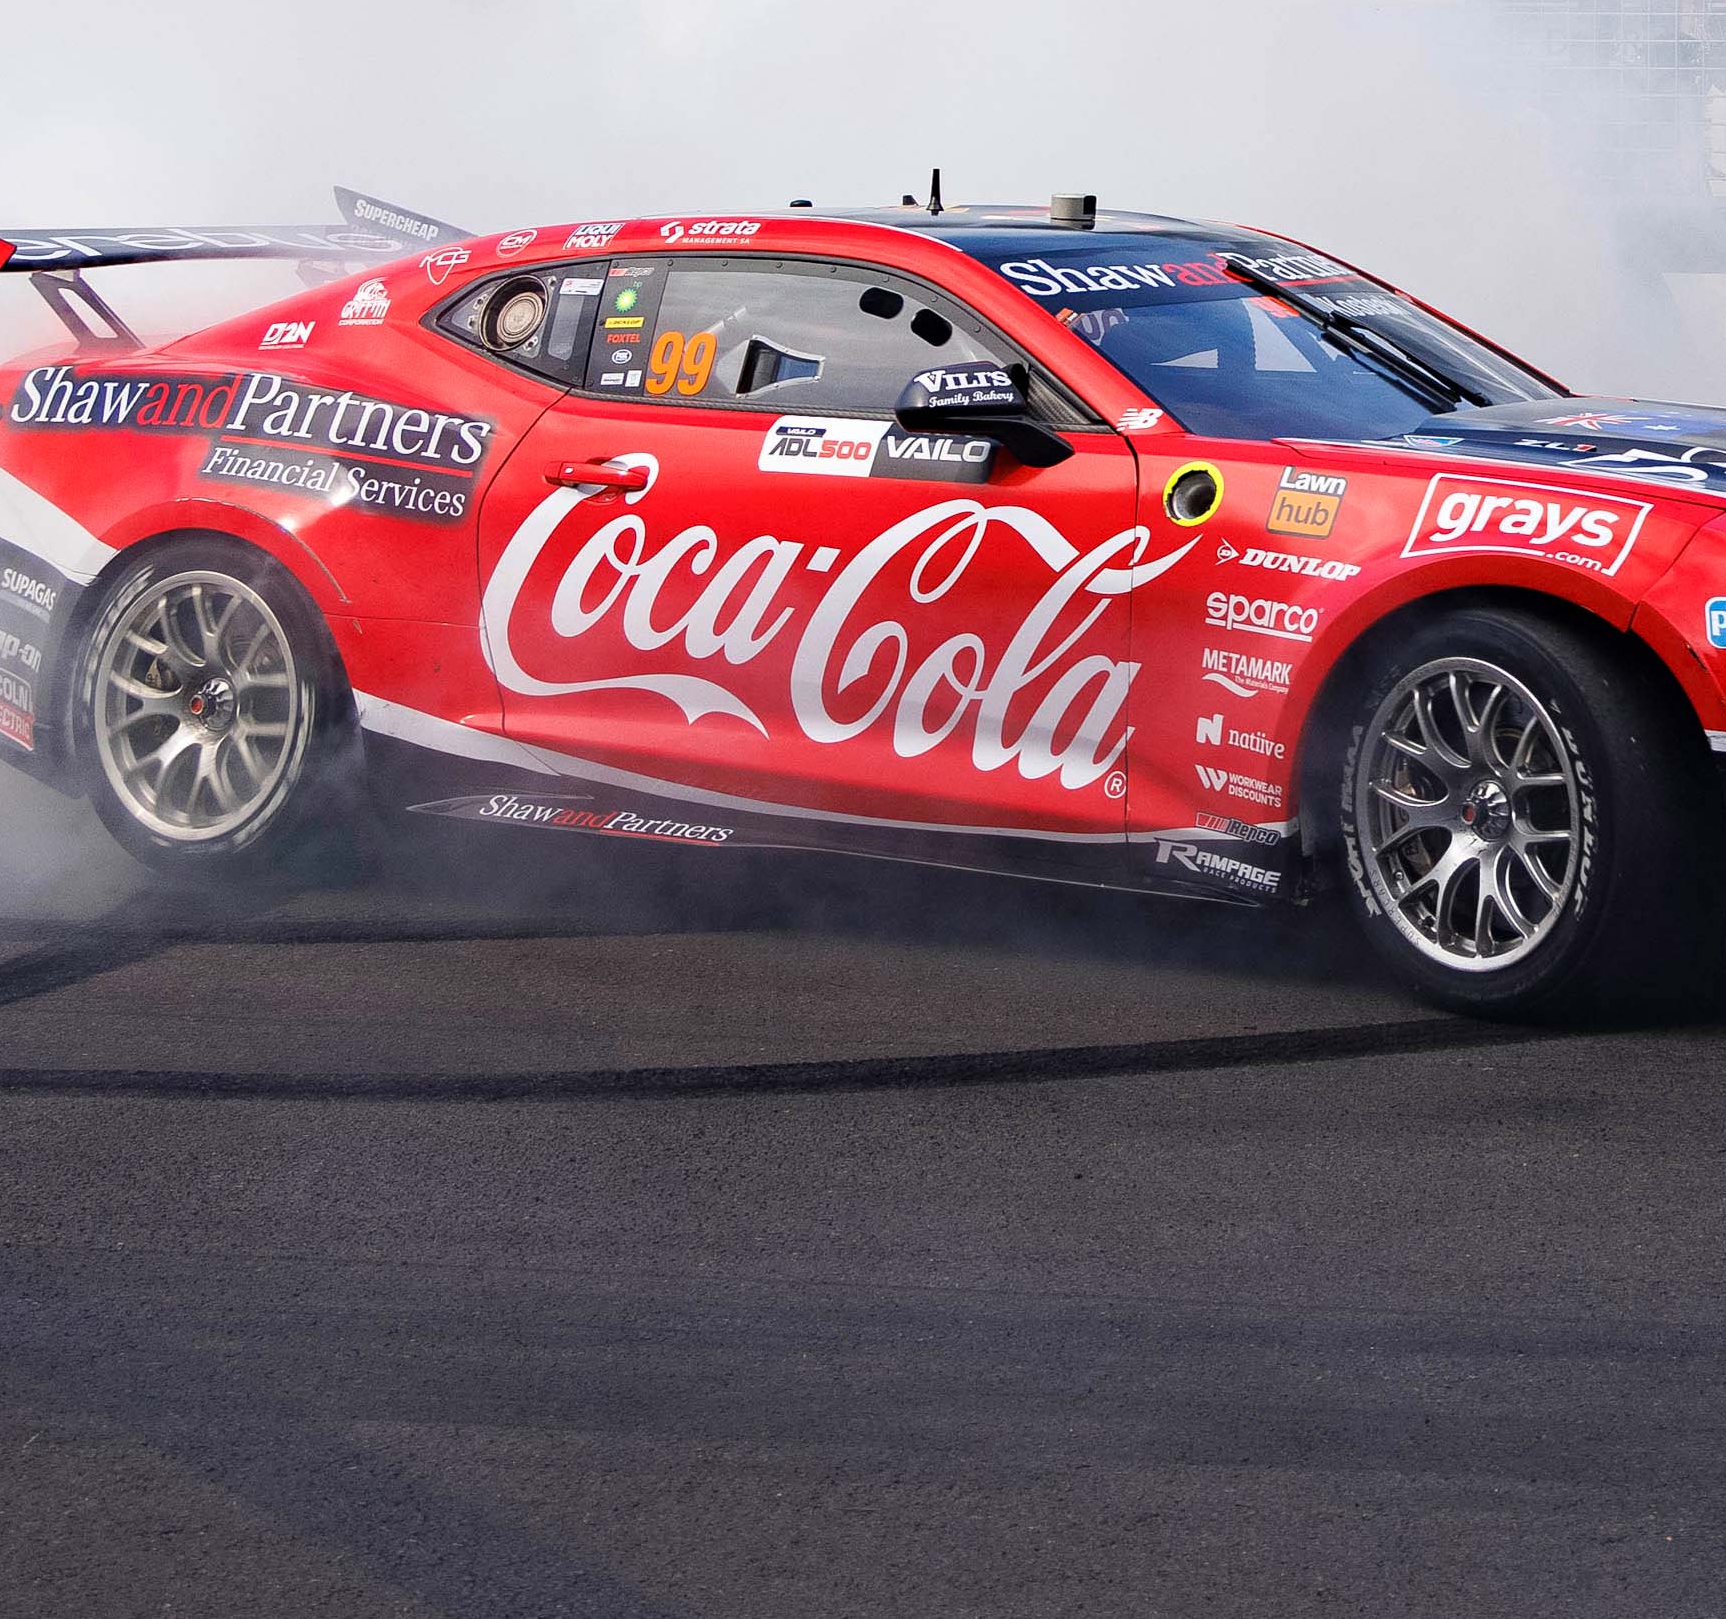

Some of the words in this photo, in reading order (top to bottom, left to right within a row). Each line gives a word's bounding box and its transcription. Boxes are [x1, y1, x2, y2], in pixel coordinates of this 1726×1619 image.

[354, 199, 439, 242] SUPERCHEAP
[574, 224, 622, 236] LIQUI
[688, 220, 762, 235] strata
[566, 234, 613, 249] MOLY
[682, 236, 738, 245] MANAGEMENT
[740, 237, 750, 245] SA
[606, 333, 641, 344] FOXTEL
[645, 331, 718, 396] 99
[928, 391, 970, 409] Family
[972, 389, 1016, 405] Bakery
[886, 434, 993, 464] VAILO
[202, 447, 337, 493] Financial
[332, 466, 467, 519] Services
[1279, 465, 1348, 495] Lawn
[1274, 496, 1330, 527] hub
[1429, 490, 1621, 547] grays
[1239, 547, 1361, 582] DUNLOP
[1546, 548, 1601, 572] .com
[1, 568, 57, 612] SUPAGAS
[1206, 591, 1319, 632] sparco
[1202, 647, 1293, 685] METAMARK
[1228, 728, 1285, 760] natiive
[1229, 771, 1282, 797] WORKWEAR
[1229, 784, 1282, 808] DISCOUNTS
[1229, 817, 1281, 846] Repco
[1154, 837, 1282, 884] RAMPAGE
[1229, 874, 1276, 894] PRODUCTS
